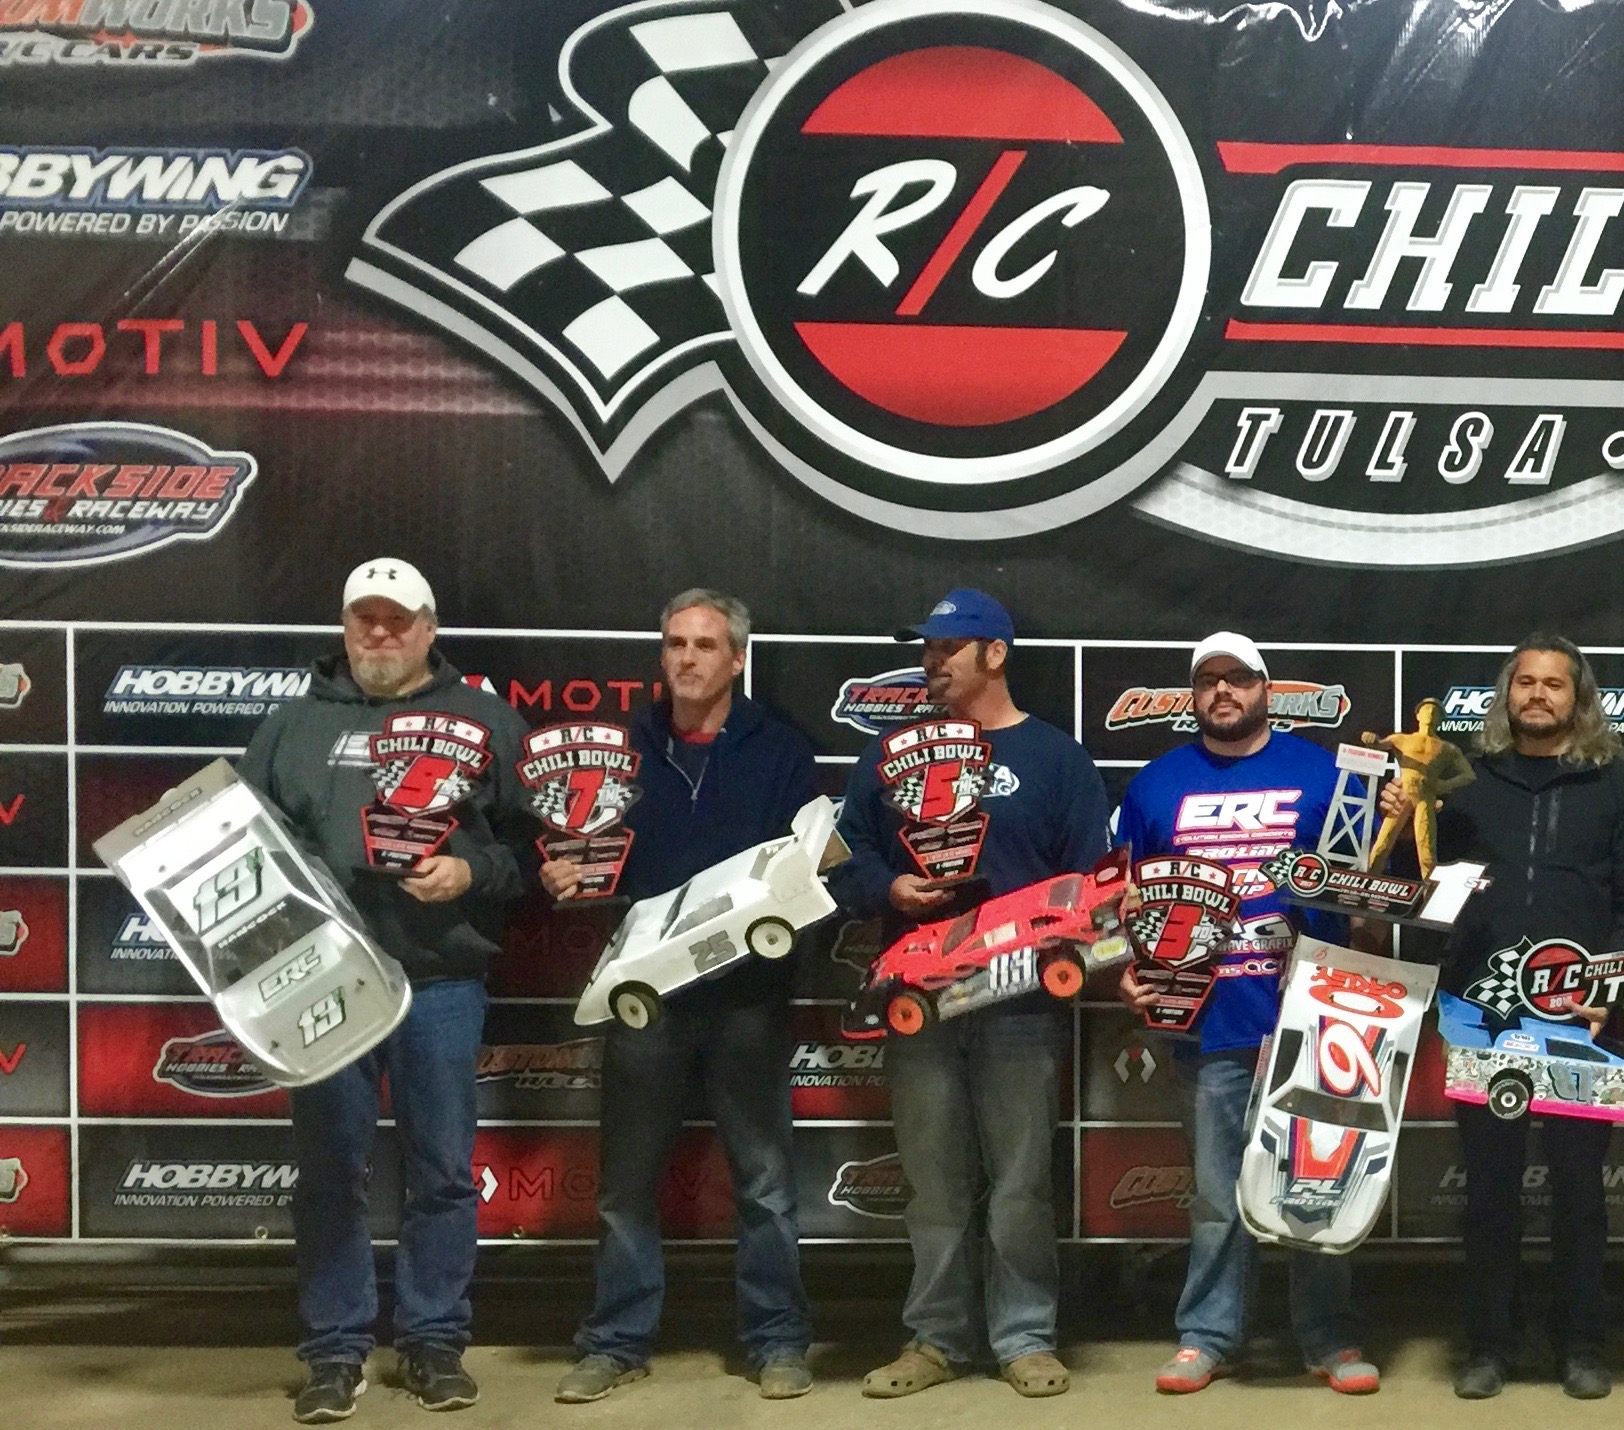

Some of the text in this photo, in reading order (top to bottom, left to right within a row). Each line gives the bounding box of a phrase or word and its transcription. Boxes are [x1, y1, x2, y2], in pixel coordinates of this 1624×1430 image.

[1, 211, 290, 234] POWERED BY PASSION
[797, 151, 1111, 316] R/C
[1225, 407, 1567, 485] TULSA
[0, 463, 239, 499] ACKSIDE
[67, 500, 220, 520] RACEWAY
[112, 669, 311, 697] HOBBYWI
[508, 679, 663, 712] MOTI
[848, 686, 929, 703] TRACK
[104, 700, 191, 715] INNOVATION
[194, 702, 266, 715] POWERED
[376, 736, 484, 769] CHILI BOWL
[522, 749, 633, 780] CHILI BOWL
[882, 743, 985, 779] CHILI BOWL
[1177, 789, 1303, 832] ERC
[1141, 883, 1231, 914] HILI BOWL
[1328, 871, 1365, 889] CHILI
[1369, 878, 1411, 897] BOWL
[689, 930, 738, 975] 25
[1584, 958, 1624, 979] CHILI
[124, 1164, 298, 1190] HOBBYW
[114, 1194, 197, 1207] INNOVATION
[200, 1194, 273, 1207] POWERED
